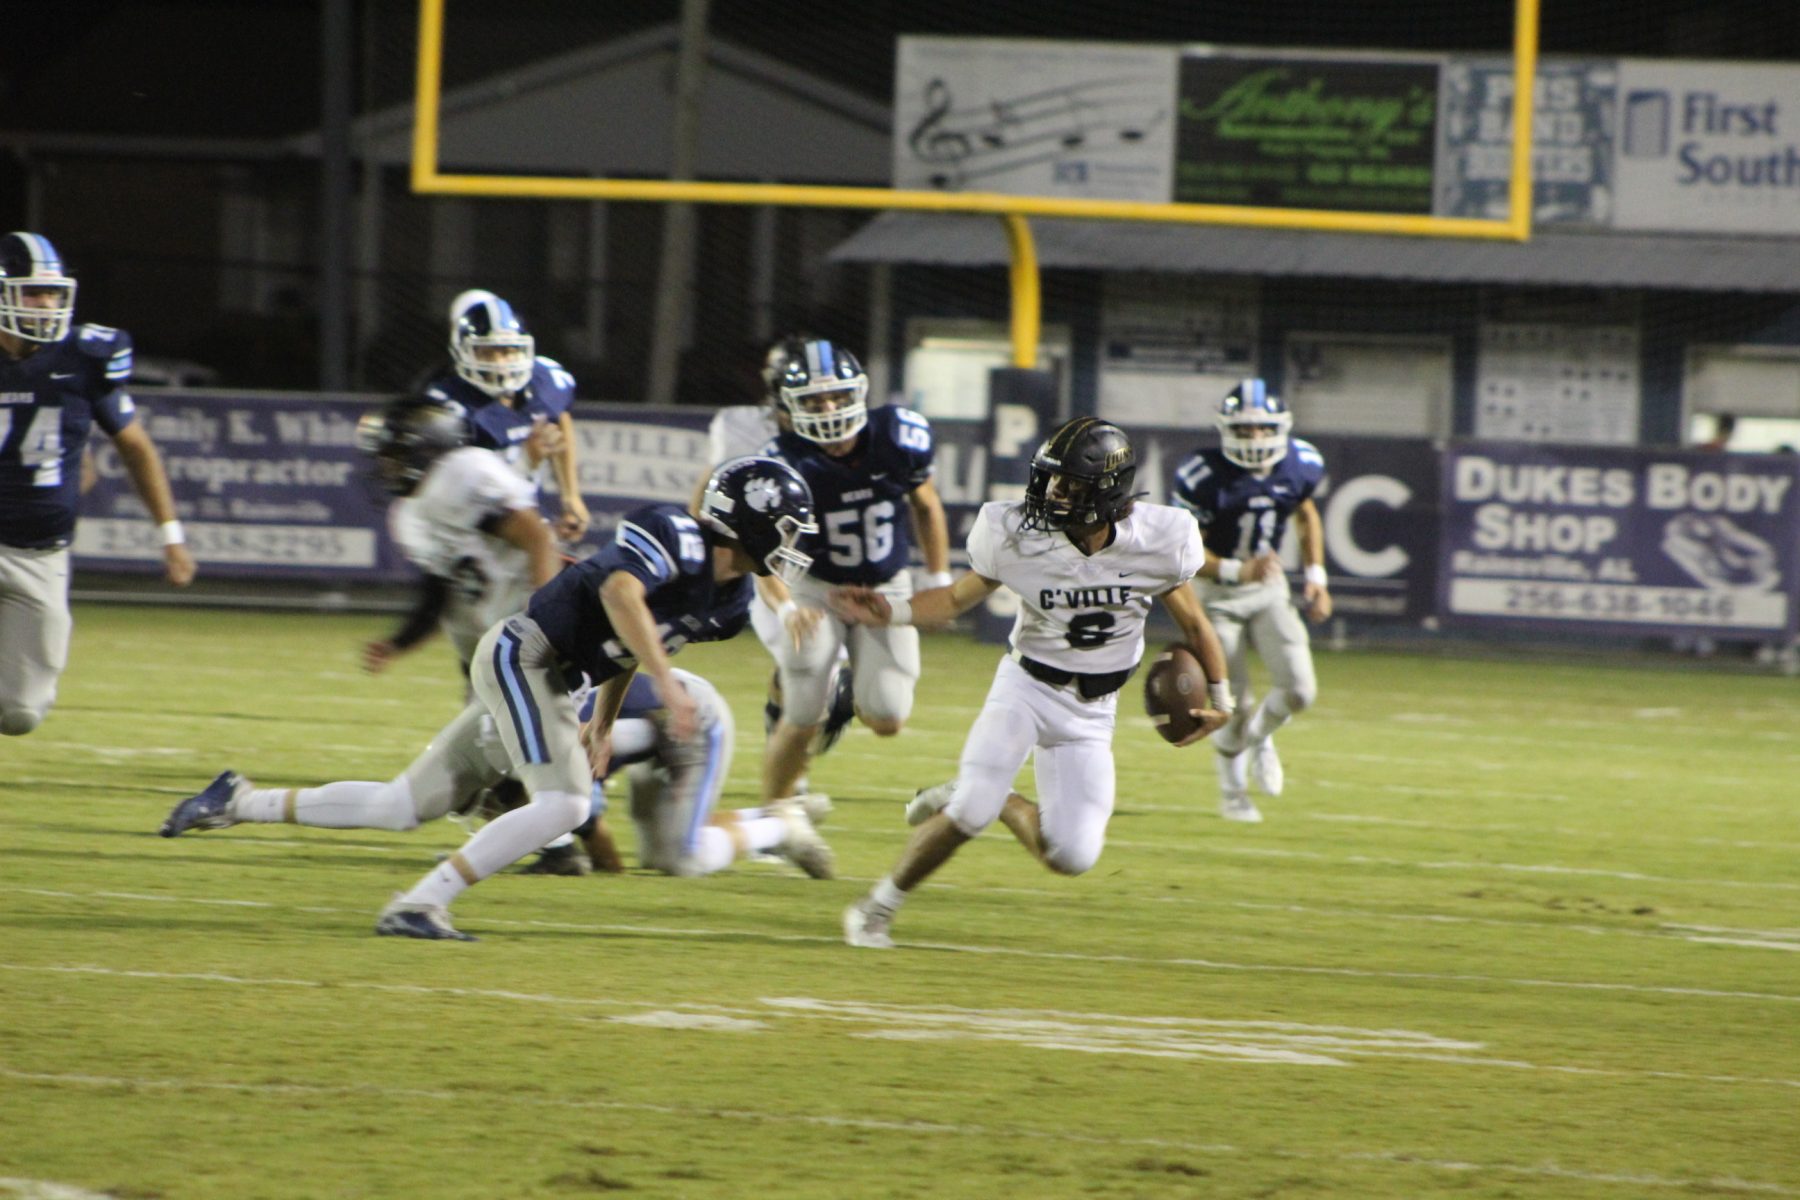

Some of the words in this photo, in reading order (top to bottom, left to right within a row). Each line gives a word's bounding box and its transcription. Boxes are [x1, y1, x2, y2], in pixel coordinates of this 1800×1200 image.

[1683, 91, 1777, 135] First
[1454, 455, 1636, 508] DUKES
[1647, 463, 1792, 514] BODY
[825, 500, 895, 567] 56
[1473, 503, 1618, 553] SHOP
